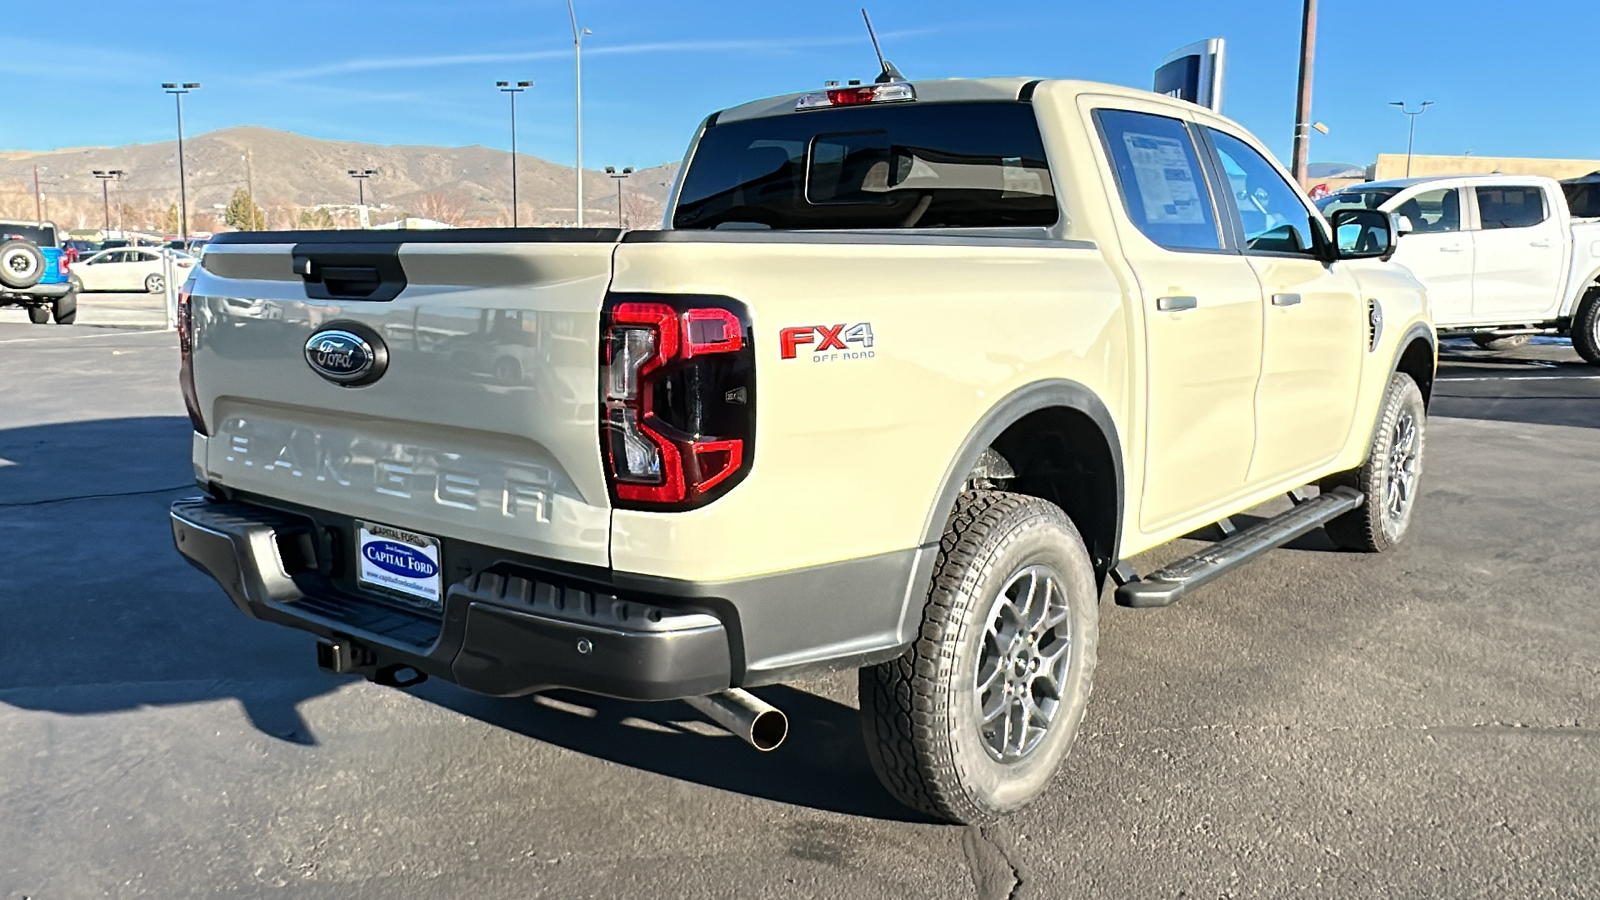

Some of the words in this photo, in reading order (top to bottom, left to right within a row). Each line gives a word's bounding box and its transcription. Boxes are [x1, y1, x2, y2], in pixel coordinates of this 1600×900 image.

[317, 340, 354, 369] Ford
[779, 322, 874, 360] FX4
[813, 354, 838, 363] OFF
[843, 350, 875, 360] ROAD
[225, 420, 554, 524] RANGER
[373, 526, 400, 540] CAPITAL
[401, 532, 420, 543] FORD
[367, 546, 405, 568] CAPITAL
[408, 557, 433, 574] FORD
